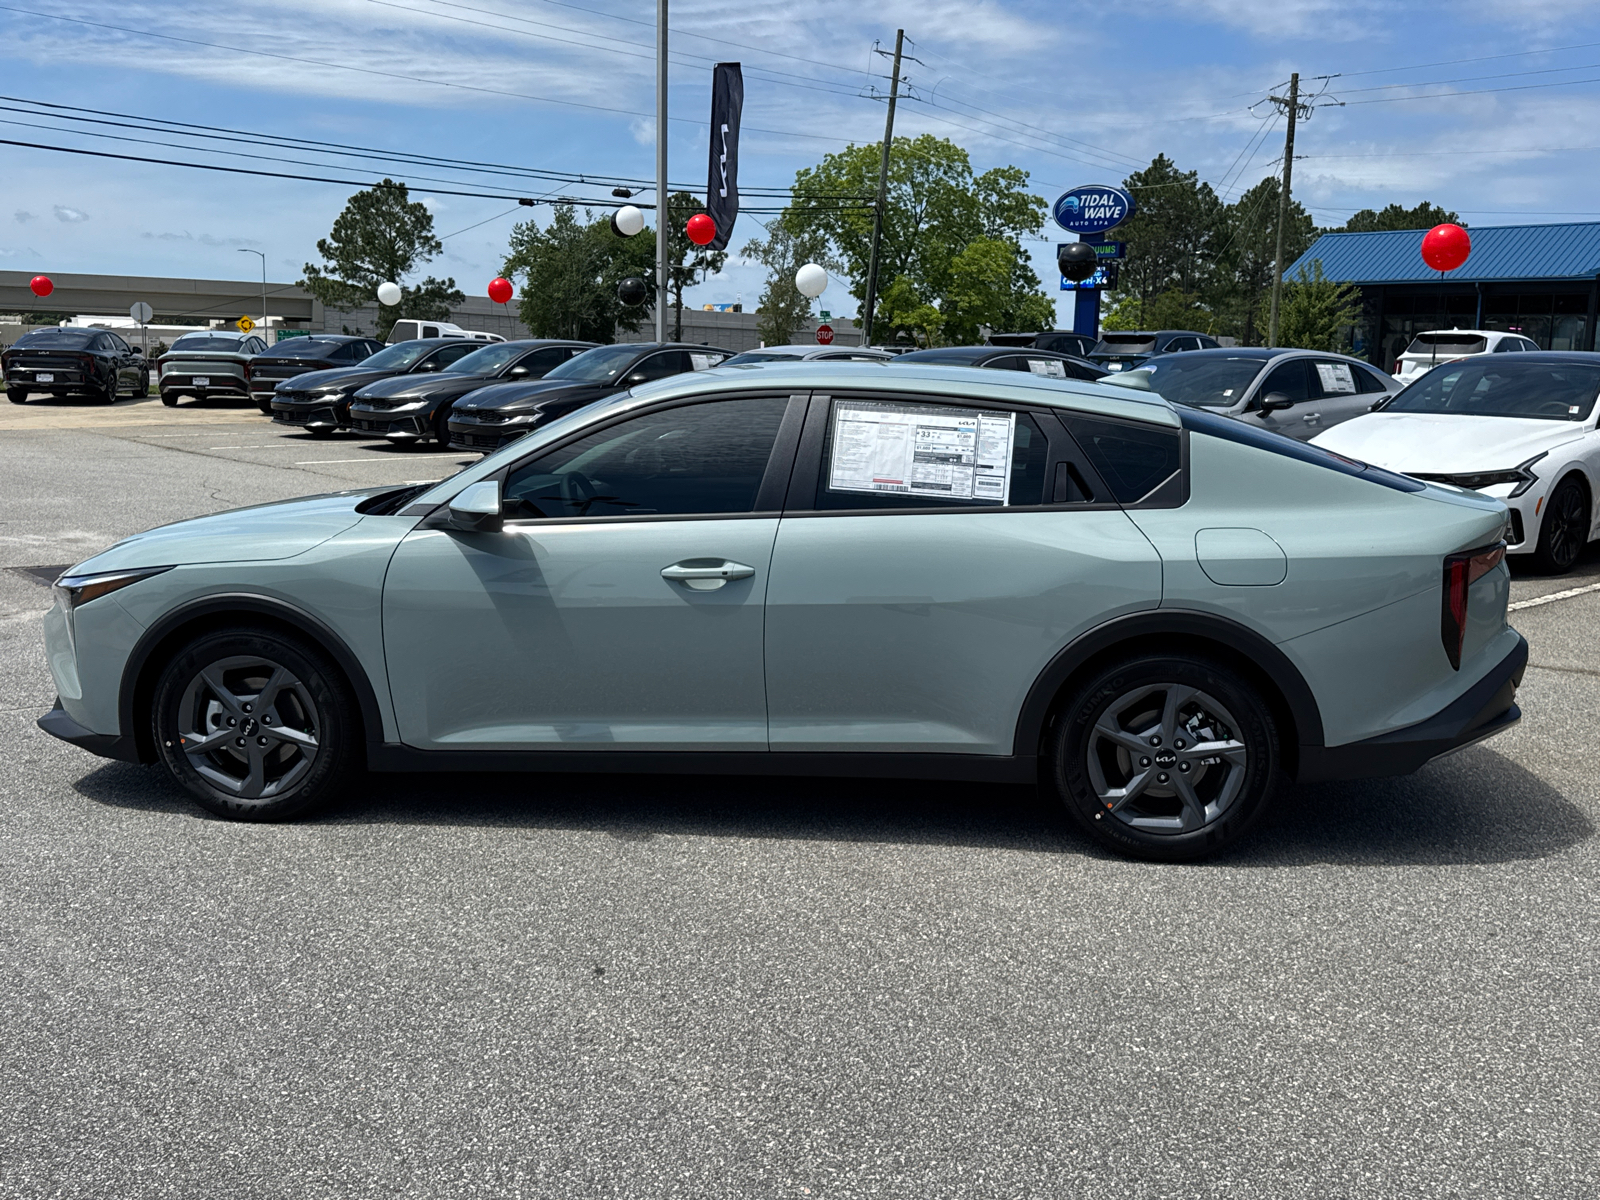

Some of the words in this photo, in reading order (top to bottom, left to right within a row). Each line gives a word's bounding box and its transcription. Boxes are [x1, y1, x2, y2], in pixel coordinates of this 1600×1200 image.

[1080, 193, 1115, 207] TIDAL
[1084, 206, 1122, 219] WAVE
[817, 331, 833, 340] STOP
[243, 719, 255, 736] KIA
